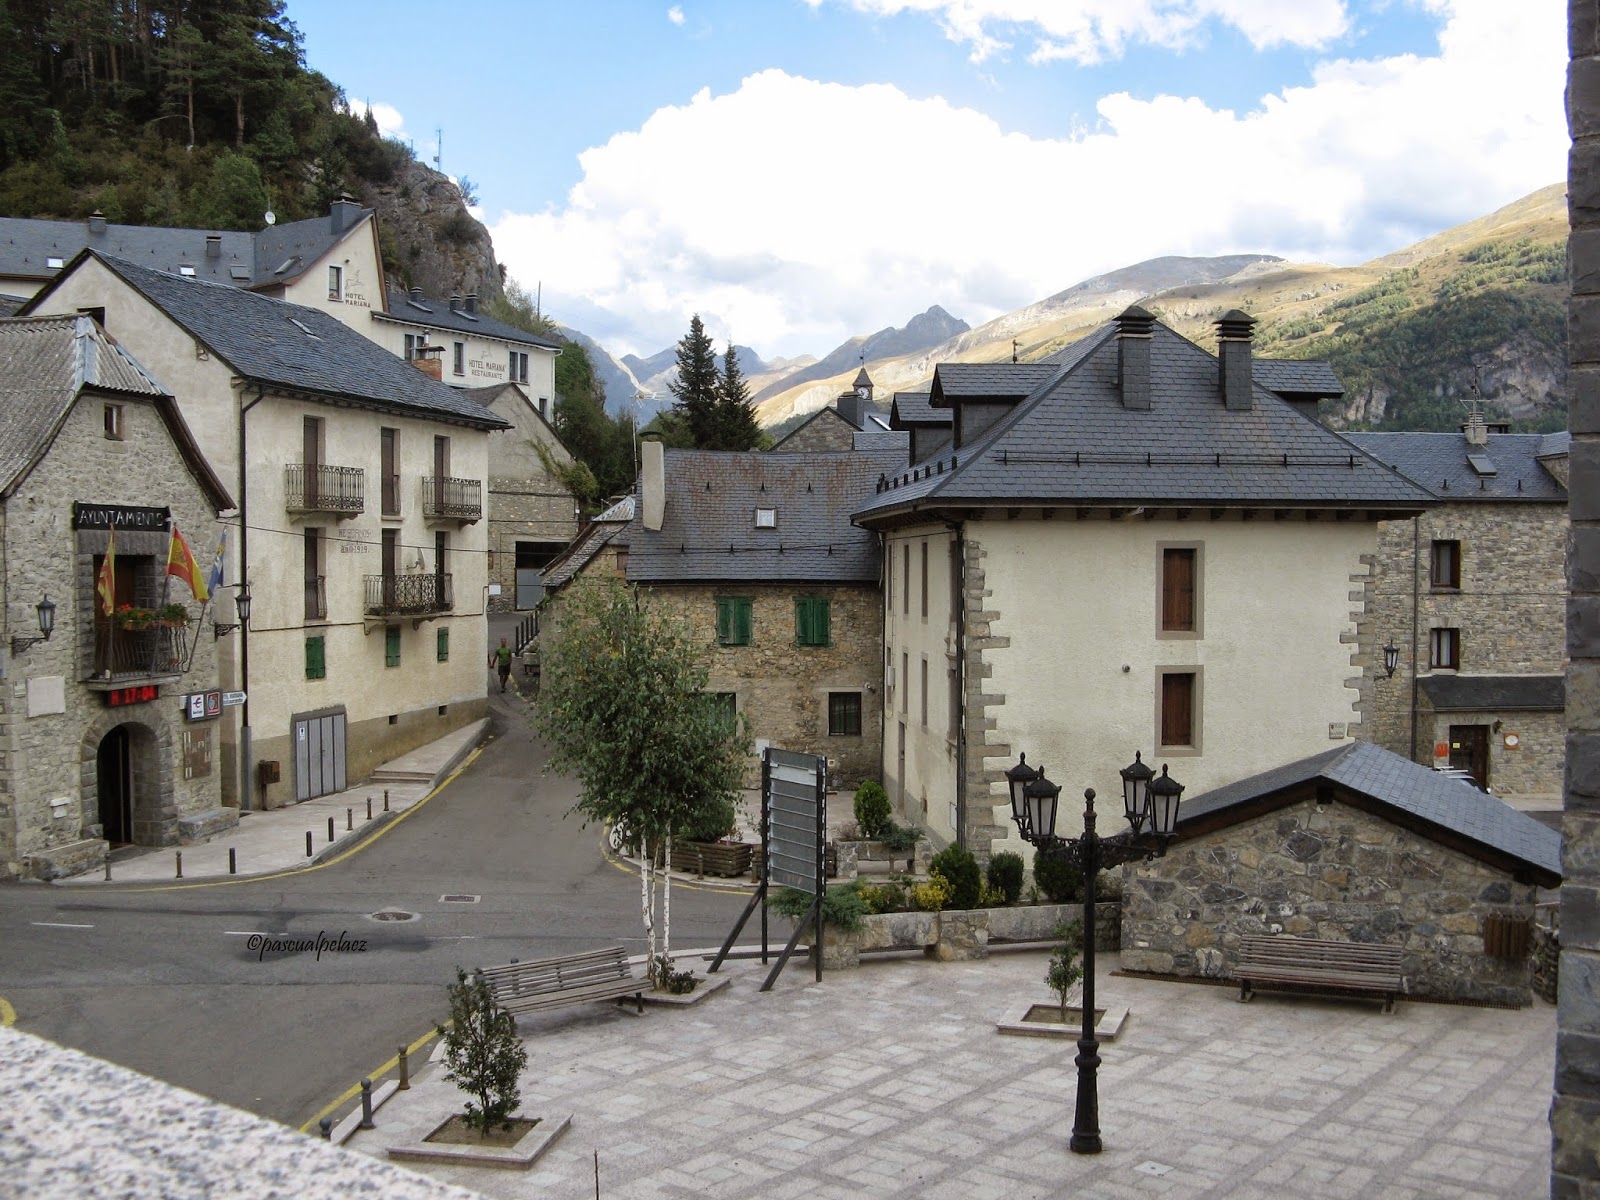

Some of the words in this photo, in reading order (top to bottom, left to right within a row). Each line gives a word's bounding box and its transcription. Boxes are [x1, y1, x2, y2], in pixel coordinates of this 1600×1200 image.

[345, 292, 365, 301] HOTEL
[345, 299, 371, 308] MARIANA
[468, 360, 484, 369] HOTEL
[485, 362, 506, 372] MARIANA
[471, 370, 503, 379] RESTAURANTE
